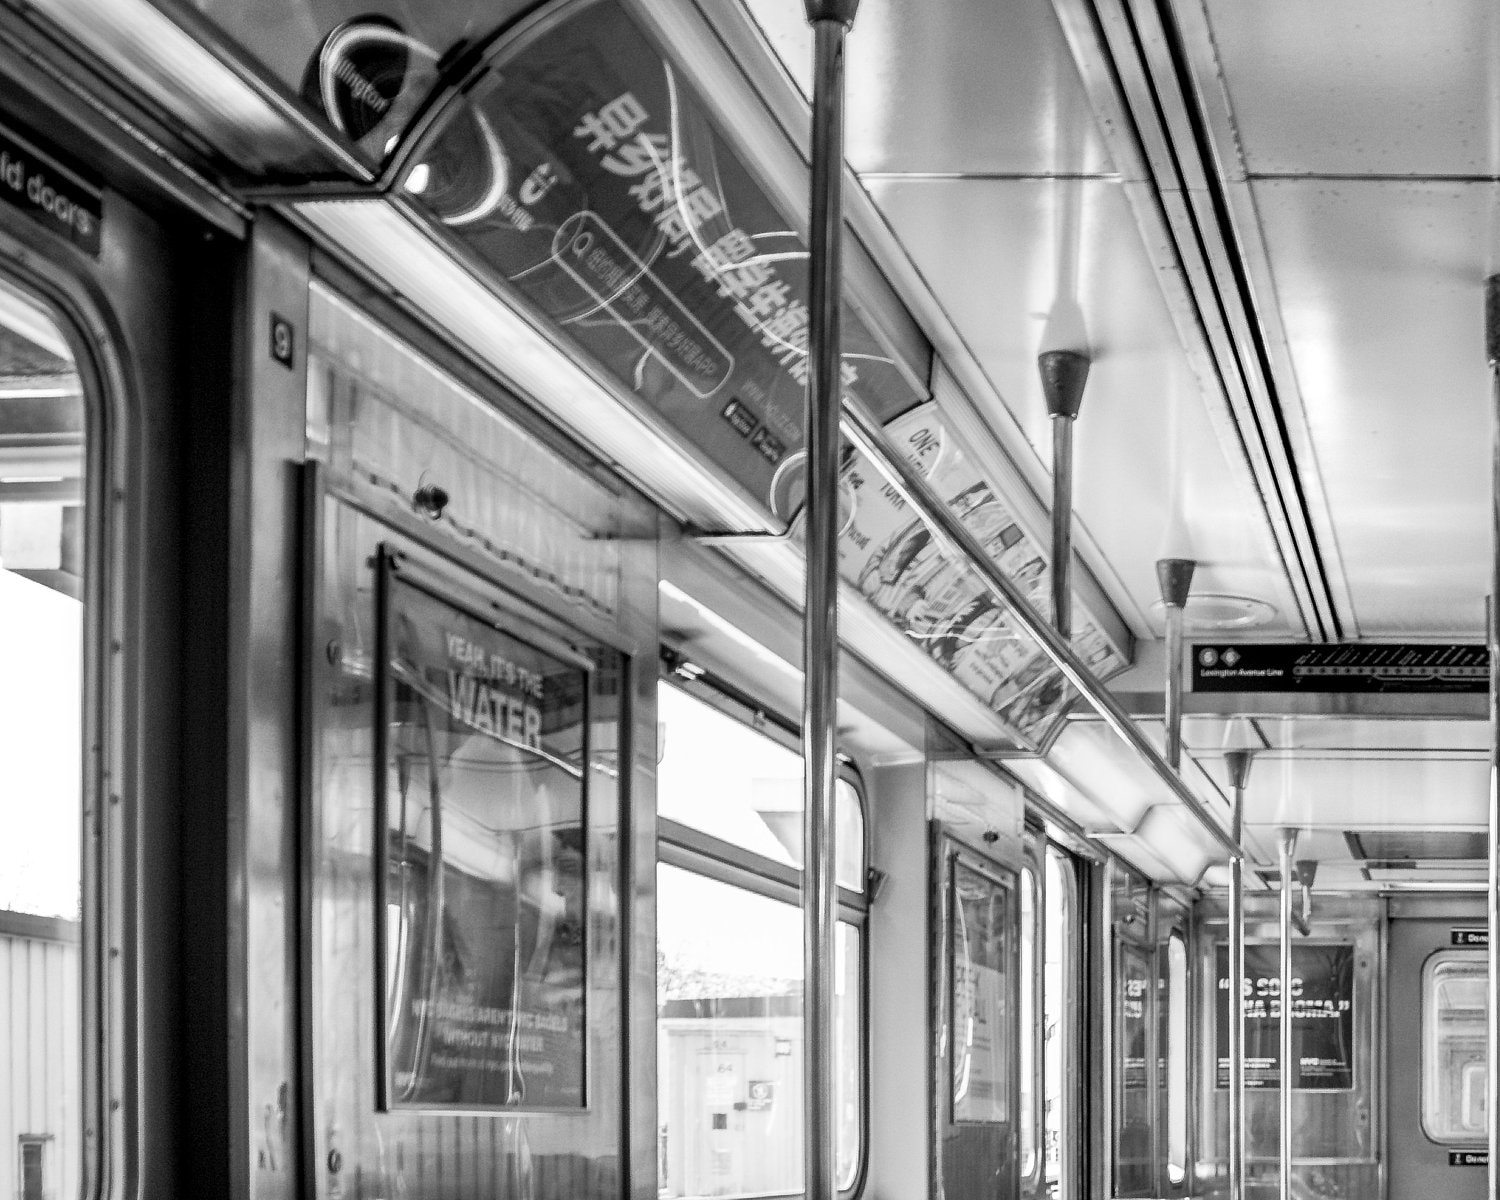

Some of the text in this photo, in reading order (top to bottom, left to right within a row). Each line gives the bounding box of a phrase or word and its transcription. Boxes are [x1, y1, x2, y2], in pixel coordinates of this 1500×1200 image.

[26, 174, 93, 236] doors
[275, 322, 290, 358] 9
[908, 427, 941, 457] ONE
[1238, 668, 1265, 677] Avenue
